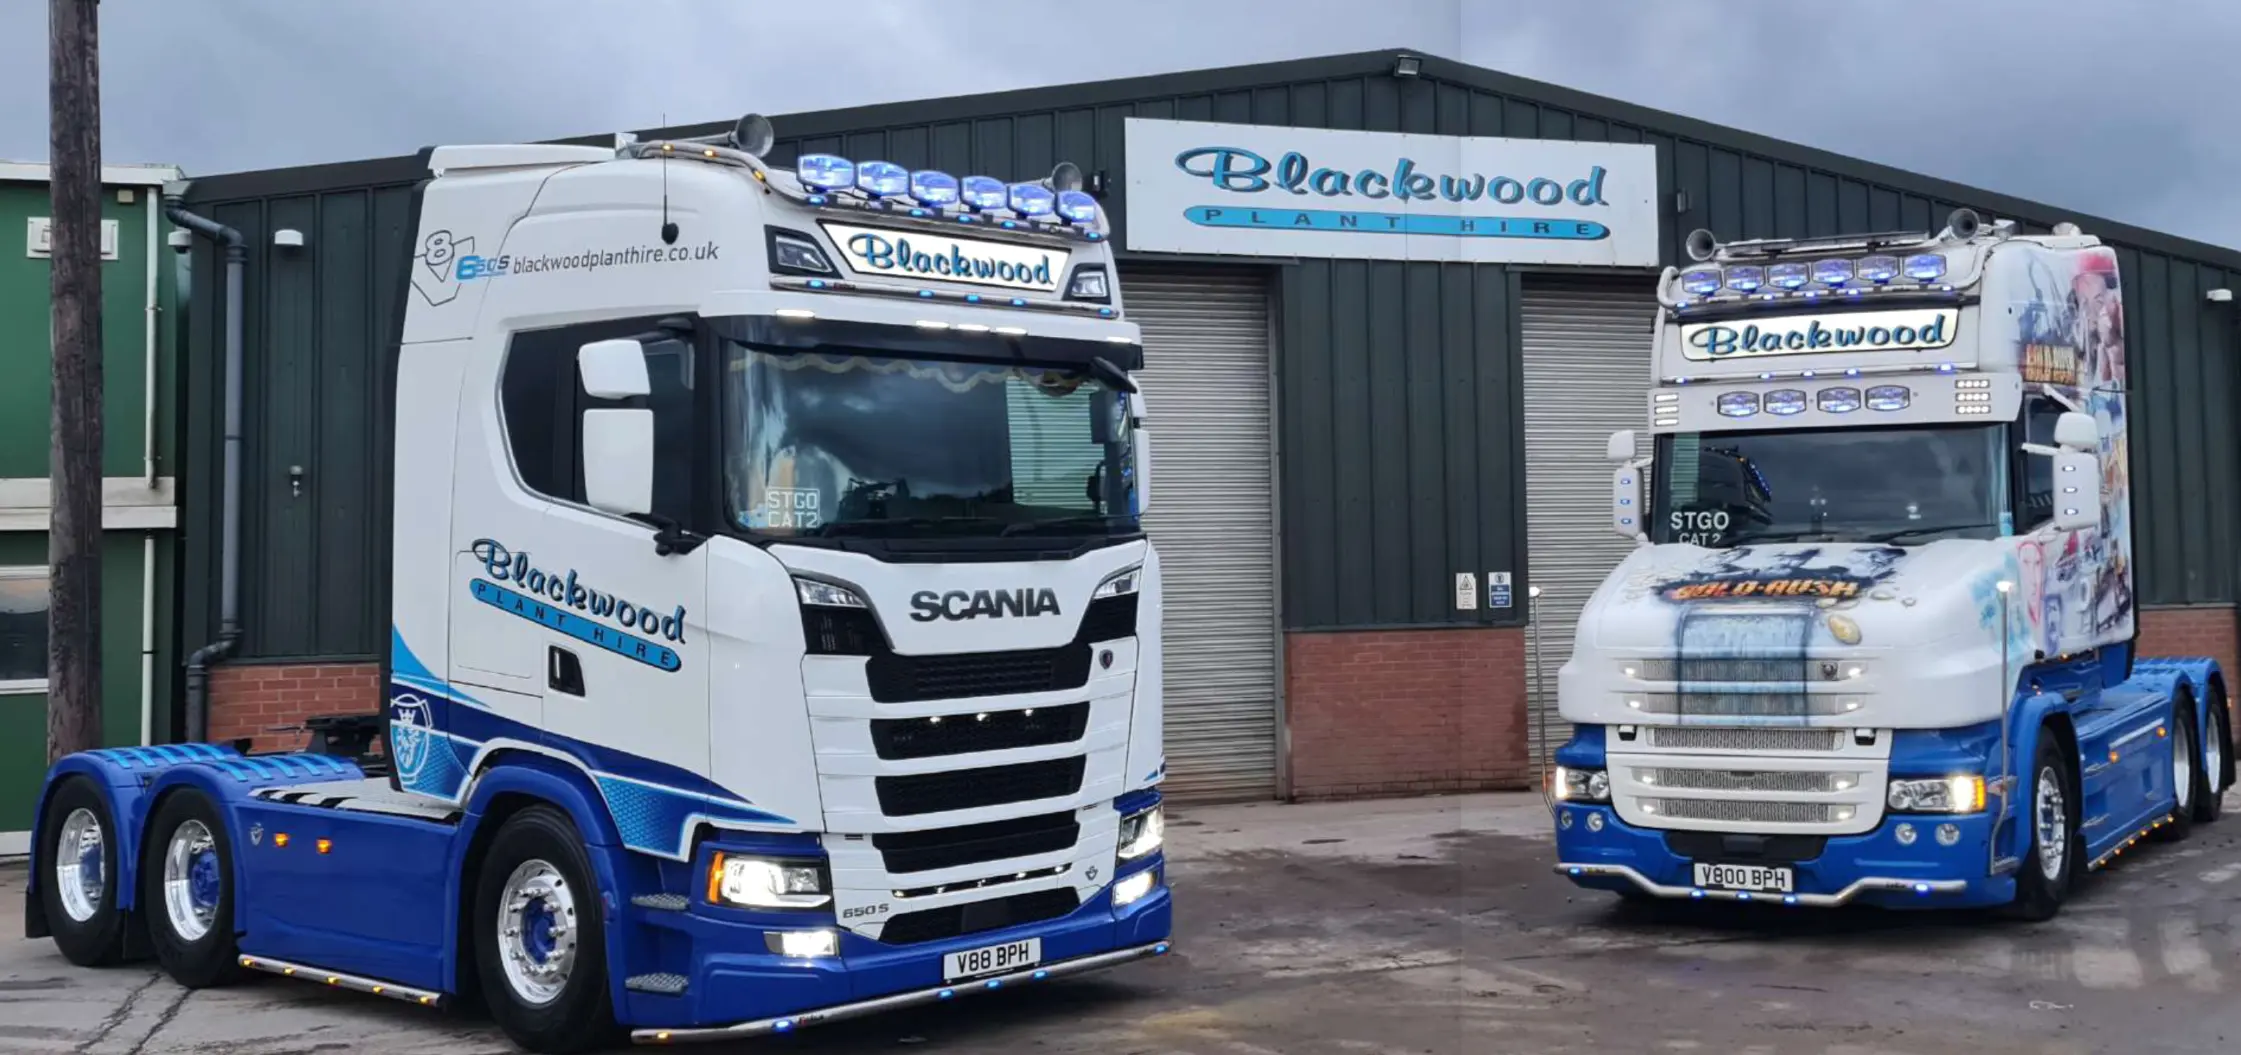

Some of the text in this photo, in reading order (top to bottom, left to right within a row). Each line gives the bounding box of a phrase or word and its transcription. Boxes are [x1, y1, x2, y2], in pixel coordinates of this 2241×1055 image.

[1175, 146, 1610, 207] Blackwood
[1205, 208, 1591, 236] PLANT HIRE
[513, 241, 720, 275] blackwoodplanthire.co.uk
[847, 233, 1055, 286] Blackwood
[1689, 313, 1946, 355] Blackwood
[768, 491, 818, 509] STGO
[1670, 511, 1730, 530] STGO
[1678, 532, 1709, 546] CAT
[472, 538, 686, 644] Blackwood
[909, 587, 1061, 622] SCANIA
[477, 583, 670, 667] PLANT HIRE
[1702, 866, 1786, 888] V800 BPH
[957, 942, 1029, 974] V88 BPH
